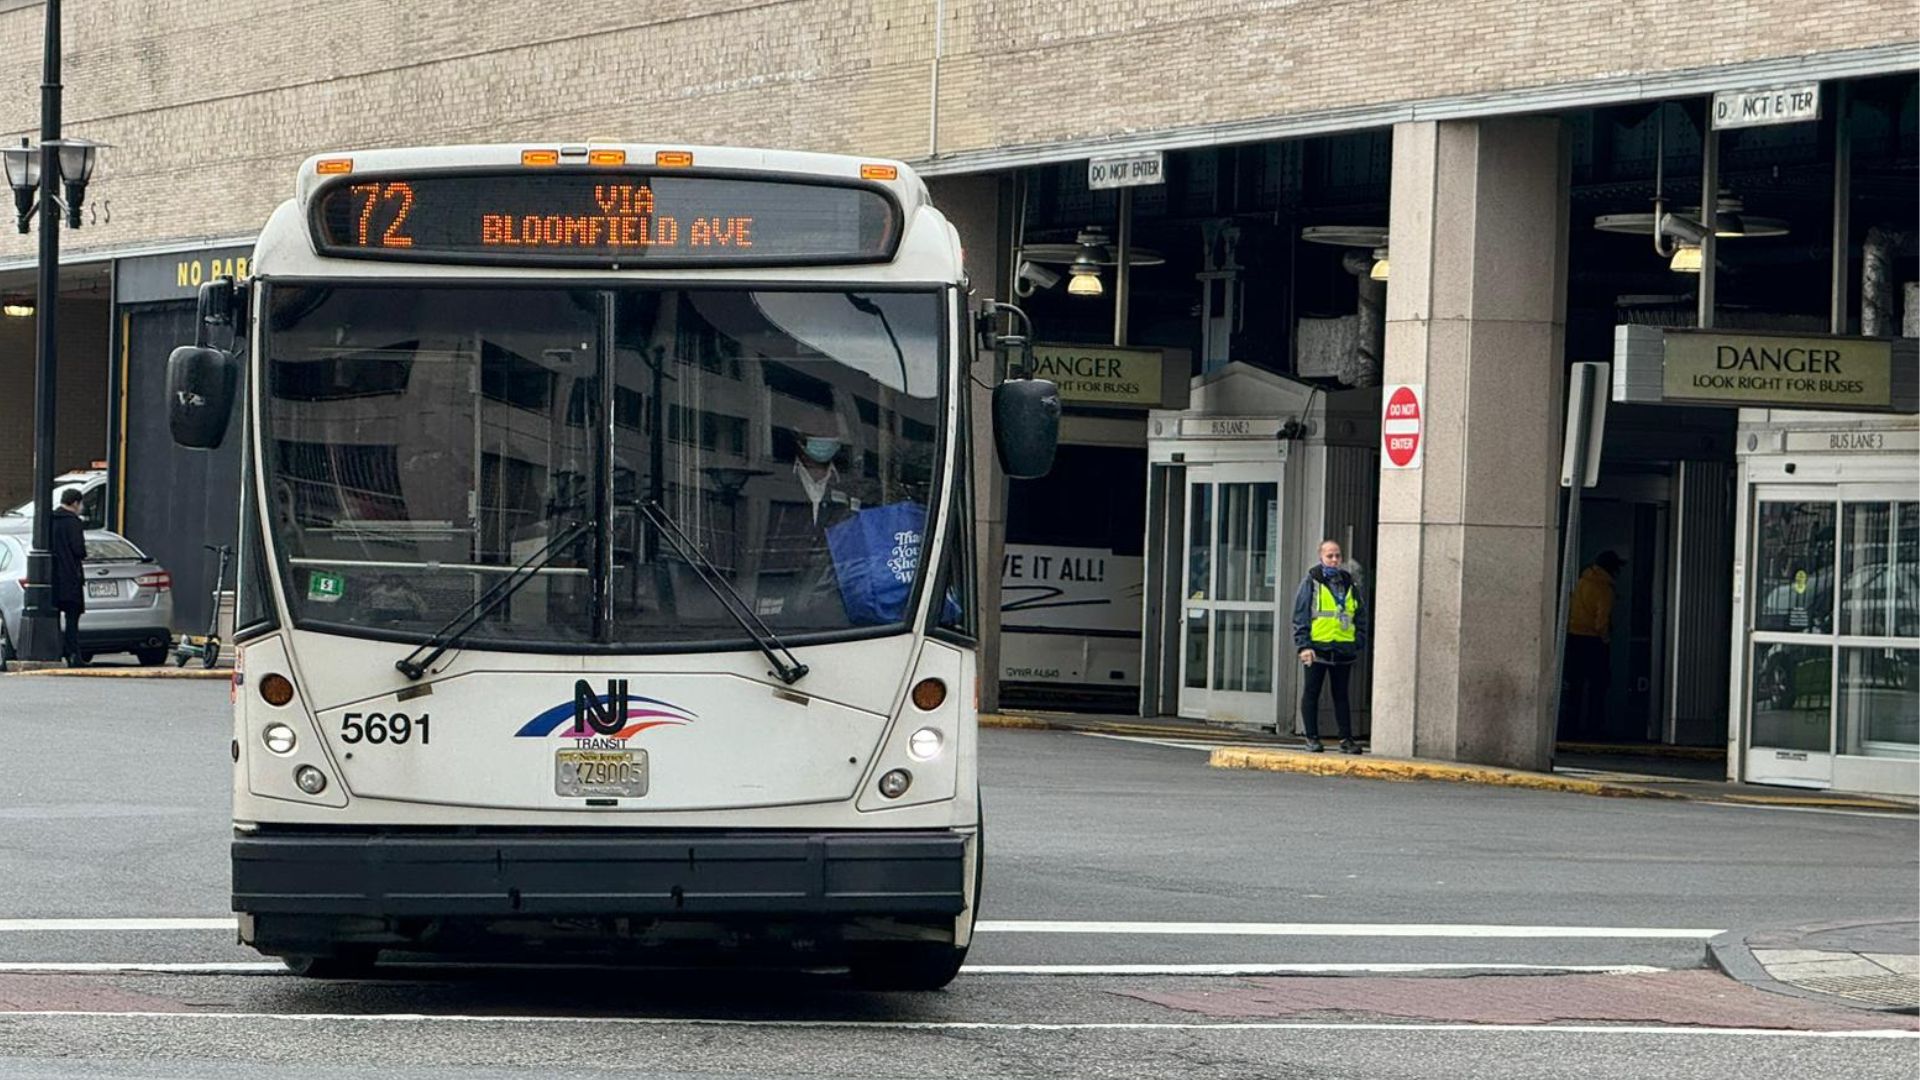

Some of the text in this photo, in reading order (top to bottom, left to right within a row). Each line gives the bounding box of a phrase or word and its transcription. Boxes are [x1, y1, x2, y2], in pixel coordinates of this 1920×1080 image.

[1775, 92, 1813, 114] ETER
[1092, 160, 1160, 182] DO NOT ENTER
[595, 183, 653, 213] VIA
[351, 182, 413, 246] 72
[482, 214, 753, 246] BLOOMFIELD AVE
[177, 260, 202, 287] NO
[1717, 345, 1841, 374] DANGER
[1077, 381, 1100, 392] FOR
[1104, 383, 1140, 394] BUSES
[1693, 374, 1864, 393] LOOK RIGHT FOR BUSES
[1390, 404, 1416, 416] DO NOT
[1211, 420, 1226, 434] BUS
[1227, 420, 1244, 434] LANE
[1391, 438, 1414, 450] ENTER
[1830, 433, 1884, 449] BUS LANE 3
[1033, 555, 1052, 579] IT
[1060, 557, 1104, 582] ALL!
[575, 678, 628, 736] NJ
[341, 712, 430, 745] 5691
[574, 738, 628, 749] TRANSIT
